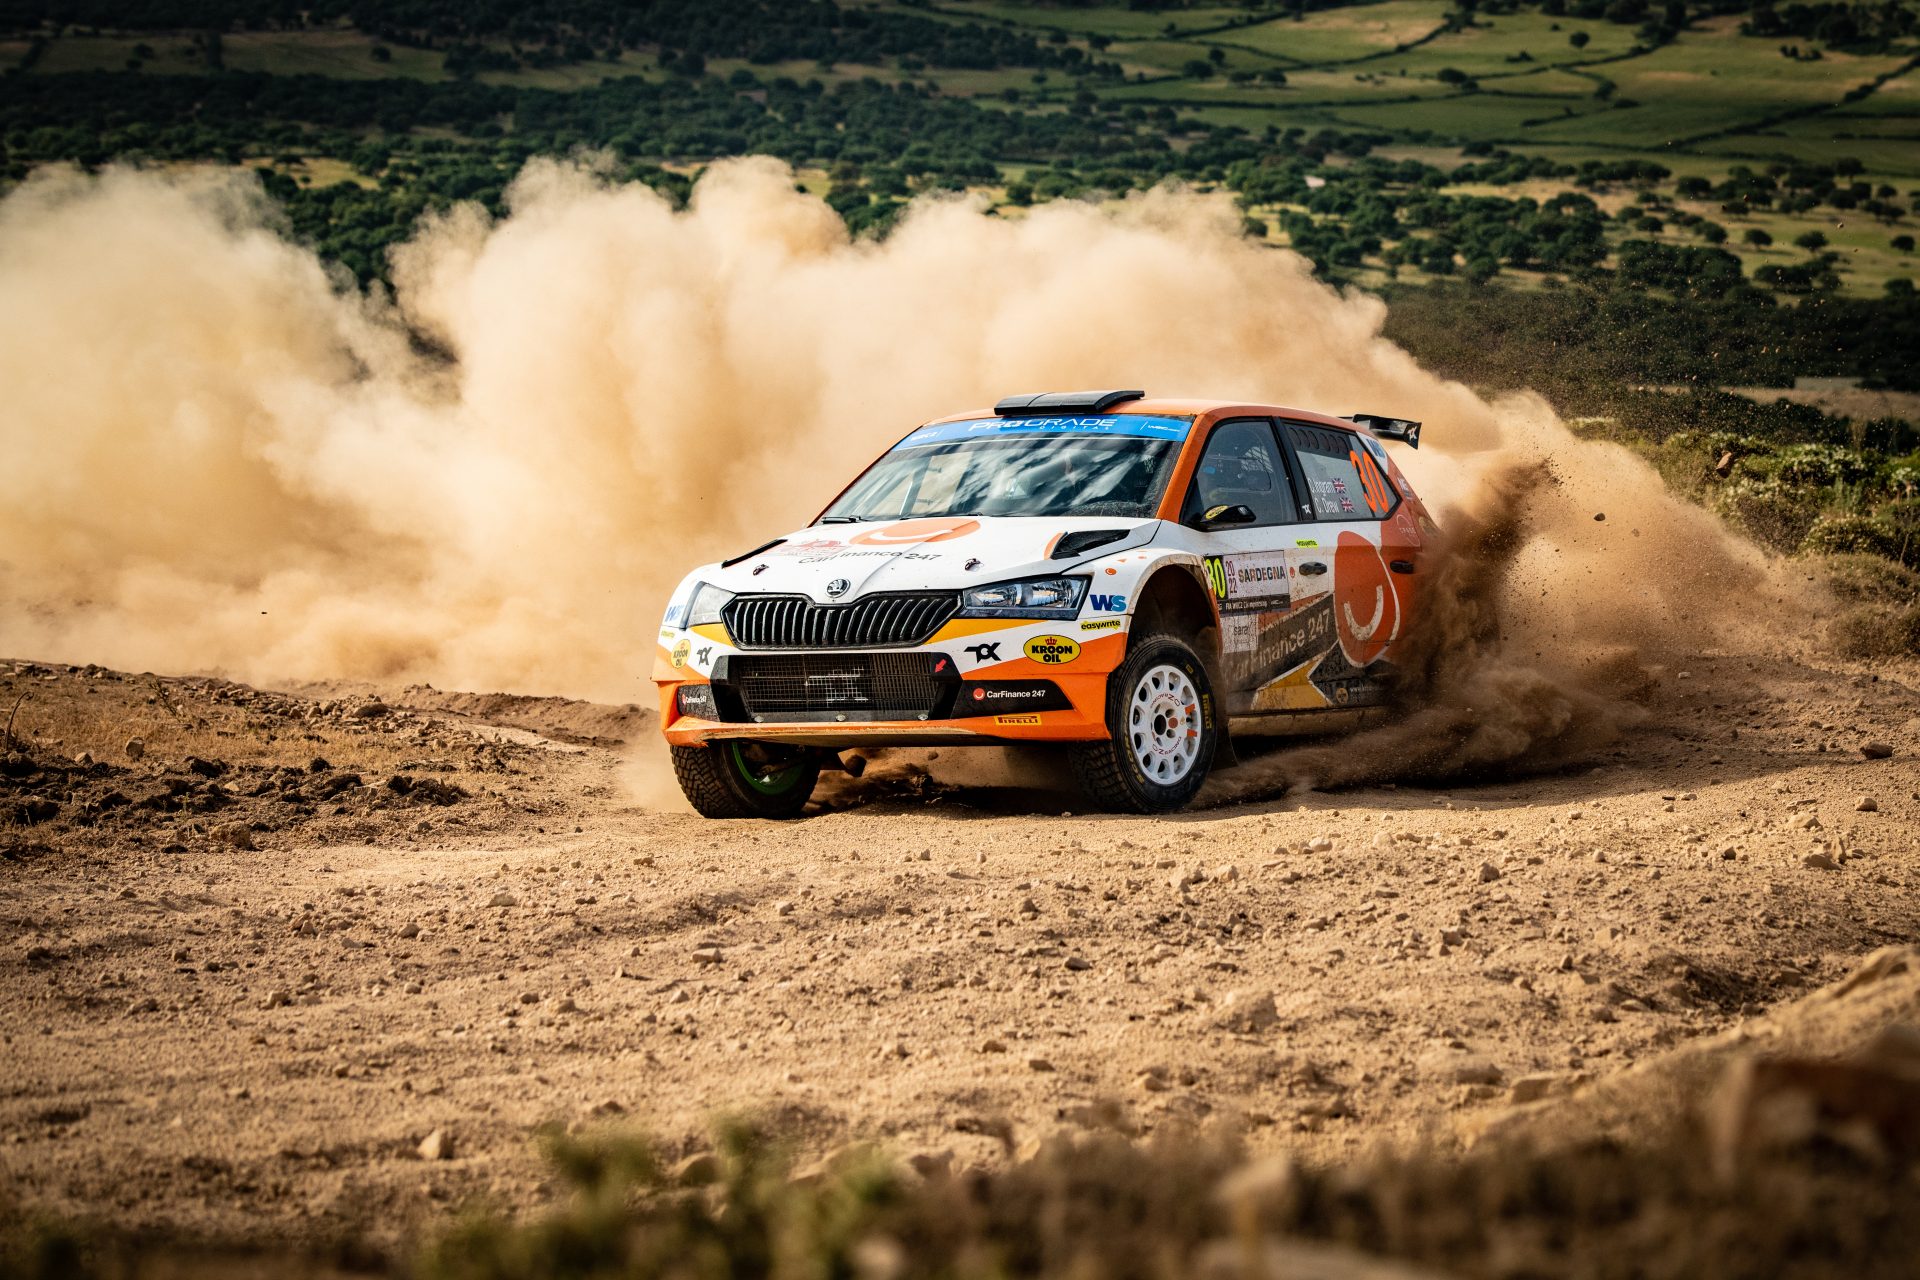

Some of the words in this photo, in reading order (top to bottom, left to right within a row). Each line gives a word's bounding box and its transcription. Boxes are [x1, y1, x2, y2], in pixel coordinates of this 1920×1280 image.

[1350, 450, 1389, 513] 30
[904, 553, 943, 561] 247
[1237, 565, 1286, 584] SARDEGNA
[1089, 594, 1127, 612] WS
[1308, 607, 1330, 642] 247
[1031, 645, 1073, 655] KROON
[1042, 654, 1062, 663] OIL
[987, 691, 1031, 699] CarFinance
[1031, 689, 1046, 697] 247
[998, 715, 1038, 724] PIRELLI
